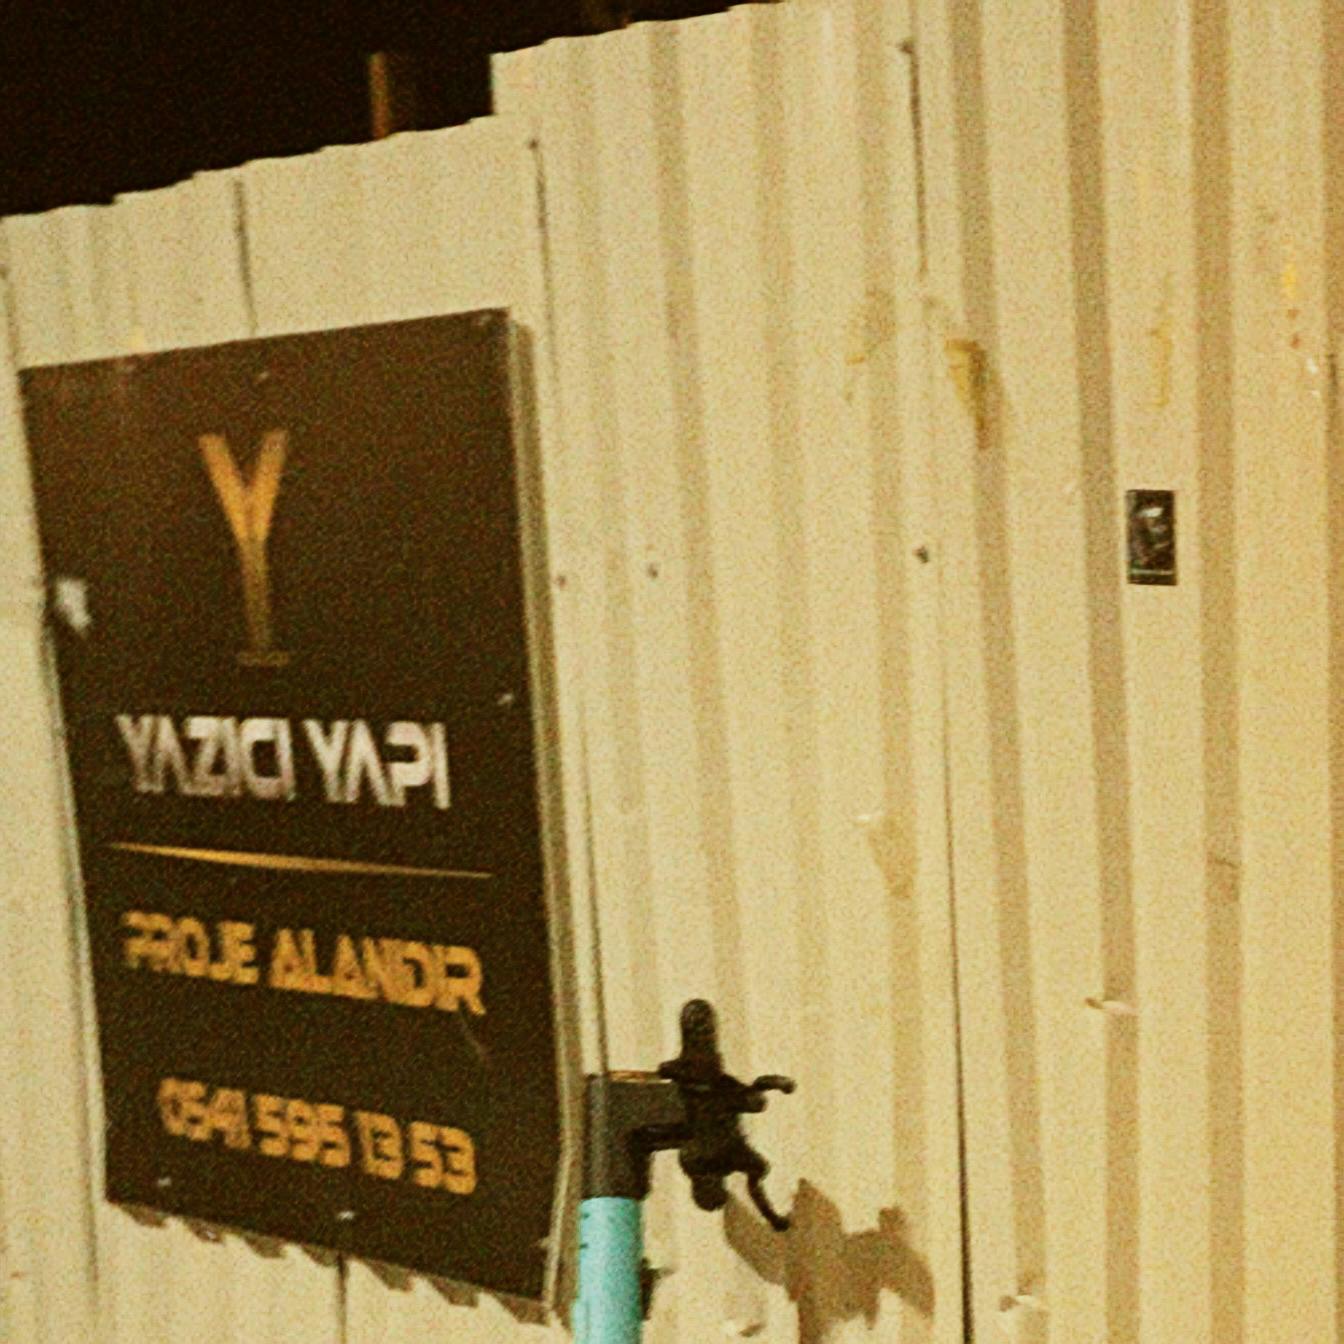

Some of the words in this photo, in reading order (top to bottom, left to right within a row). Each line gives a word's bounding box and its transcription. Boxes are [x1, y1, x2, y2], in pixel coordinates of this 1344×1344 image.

[303, 718, 451, 809] YAPI
[123, 910, 259, 985] PROJE
[409, 1121, 477, 1195] 53
